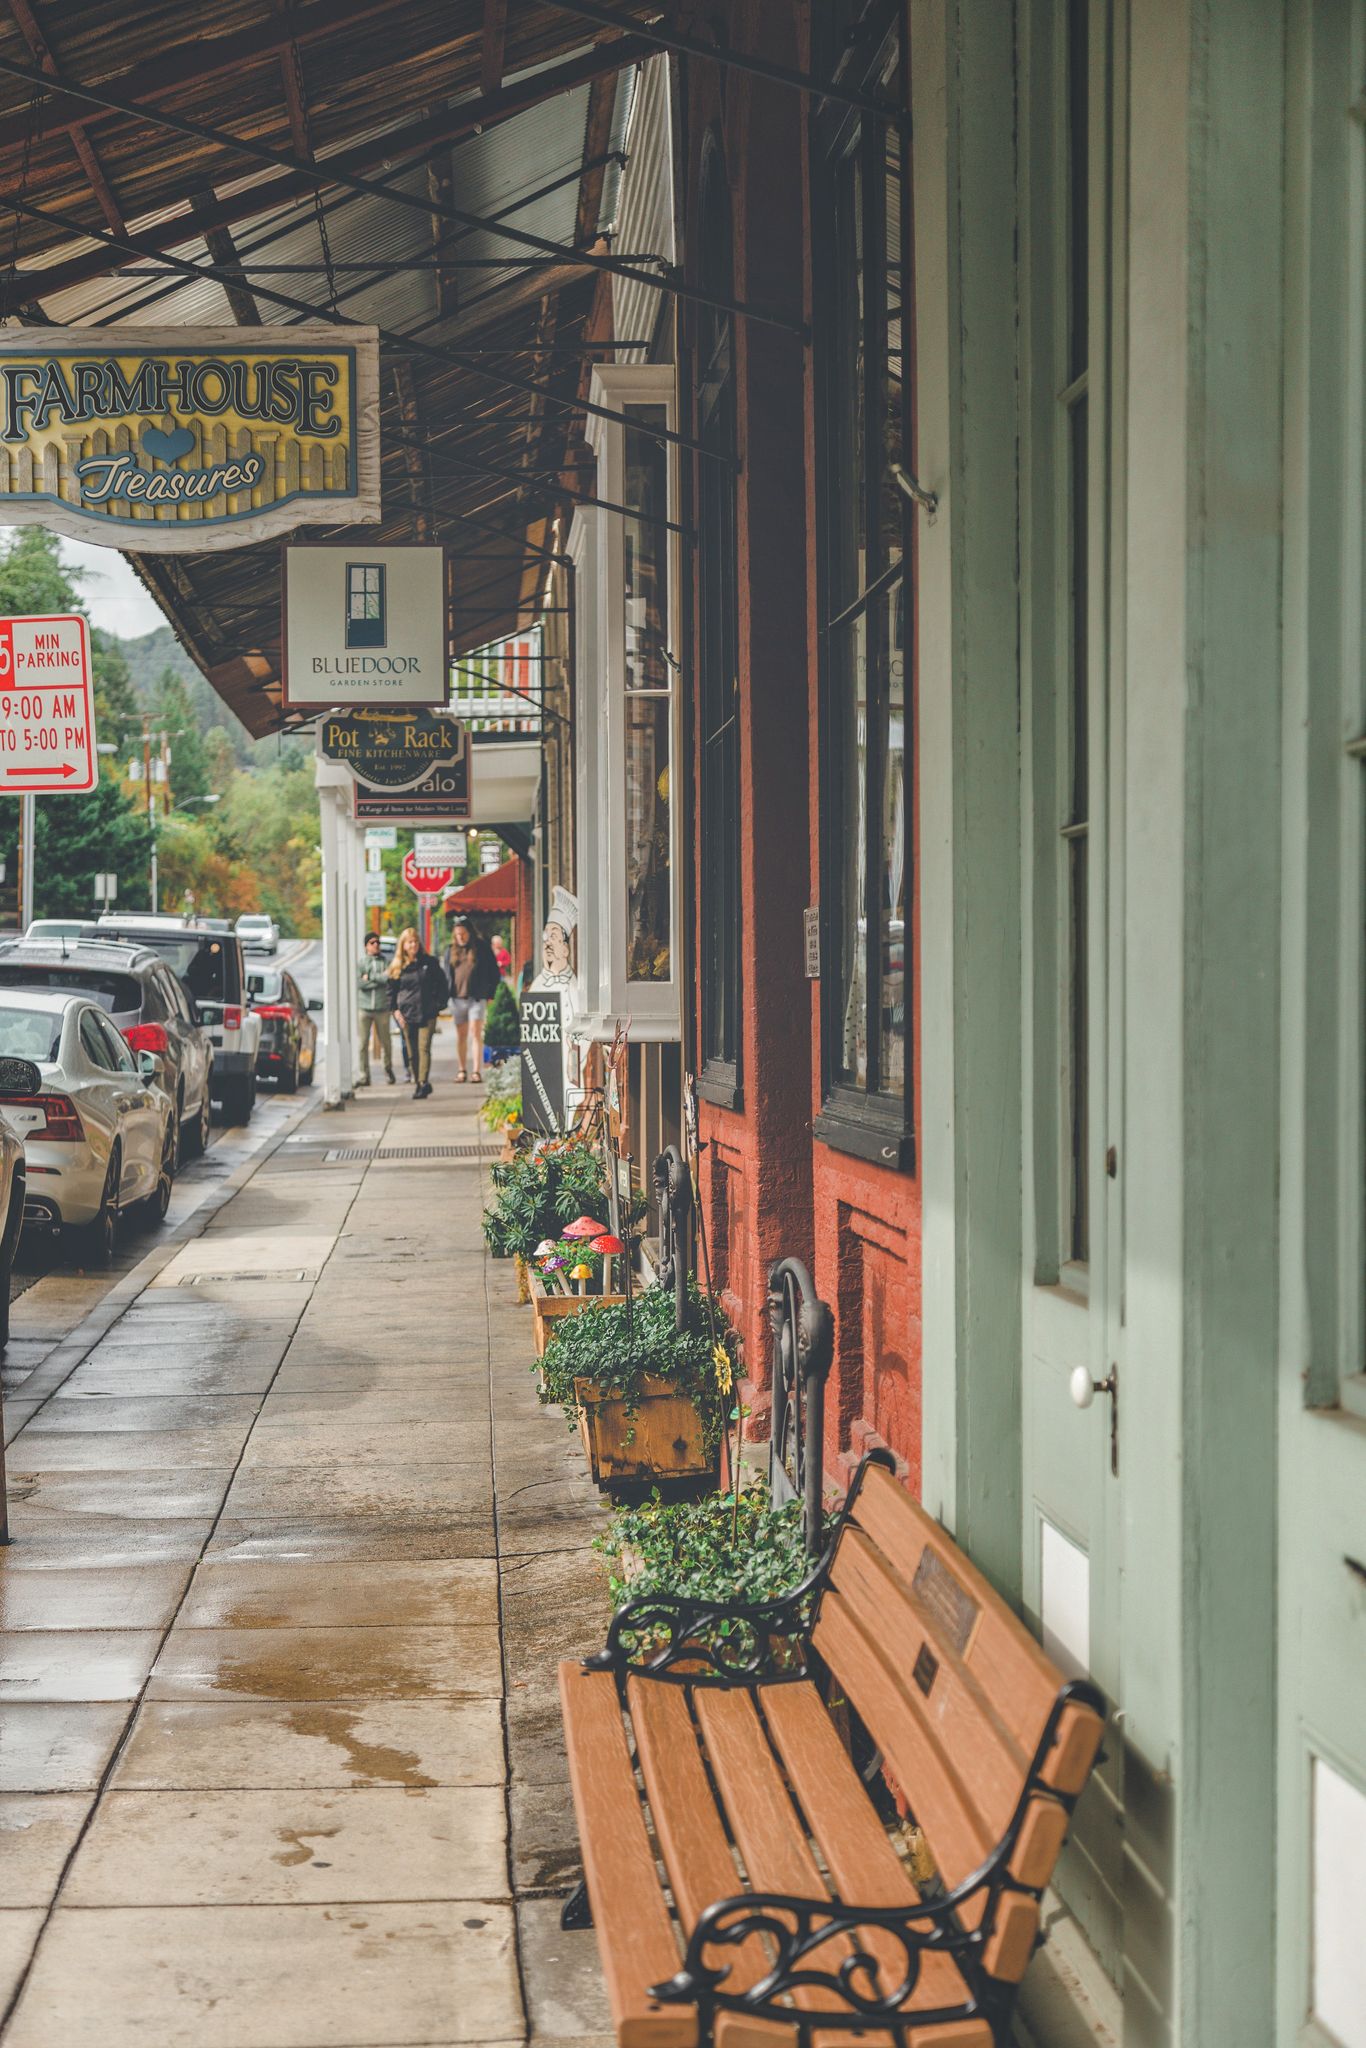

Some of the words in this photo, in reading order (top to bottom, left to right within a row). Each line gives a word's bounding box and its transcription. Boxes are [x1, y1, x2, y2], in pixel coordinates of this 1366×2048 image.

[2, 359, 342, 441] FARMHOUSE
[78, 456, 260, 499] Treasures
[35, 633, 60, 650] MIN
[17, 651, 80, 668] PARKING
[312, 656, 421, 674] BLUEDOOR
[2, 695, 43, 720] 9:00
[52, 694, 76, 719] AM
[0, 729, 16, 751] TO
[24, 728, 58, 751] 5:00
[65, 727, 85, 750] PM
[328, 725, 359, 748] Pot
[404, 725, 453, 748] Rack
[338, 749, 362, 758] FINE
[366, 749, 441, 758] KITCHENWARE
[521, 1001, 558, 1021] POT
[520, 1023, 561, 1043] RACK
[522, 1048, 537, 1073] FINE
